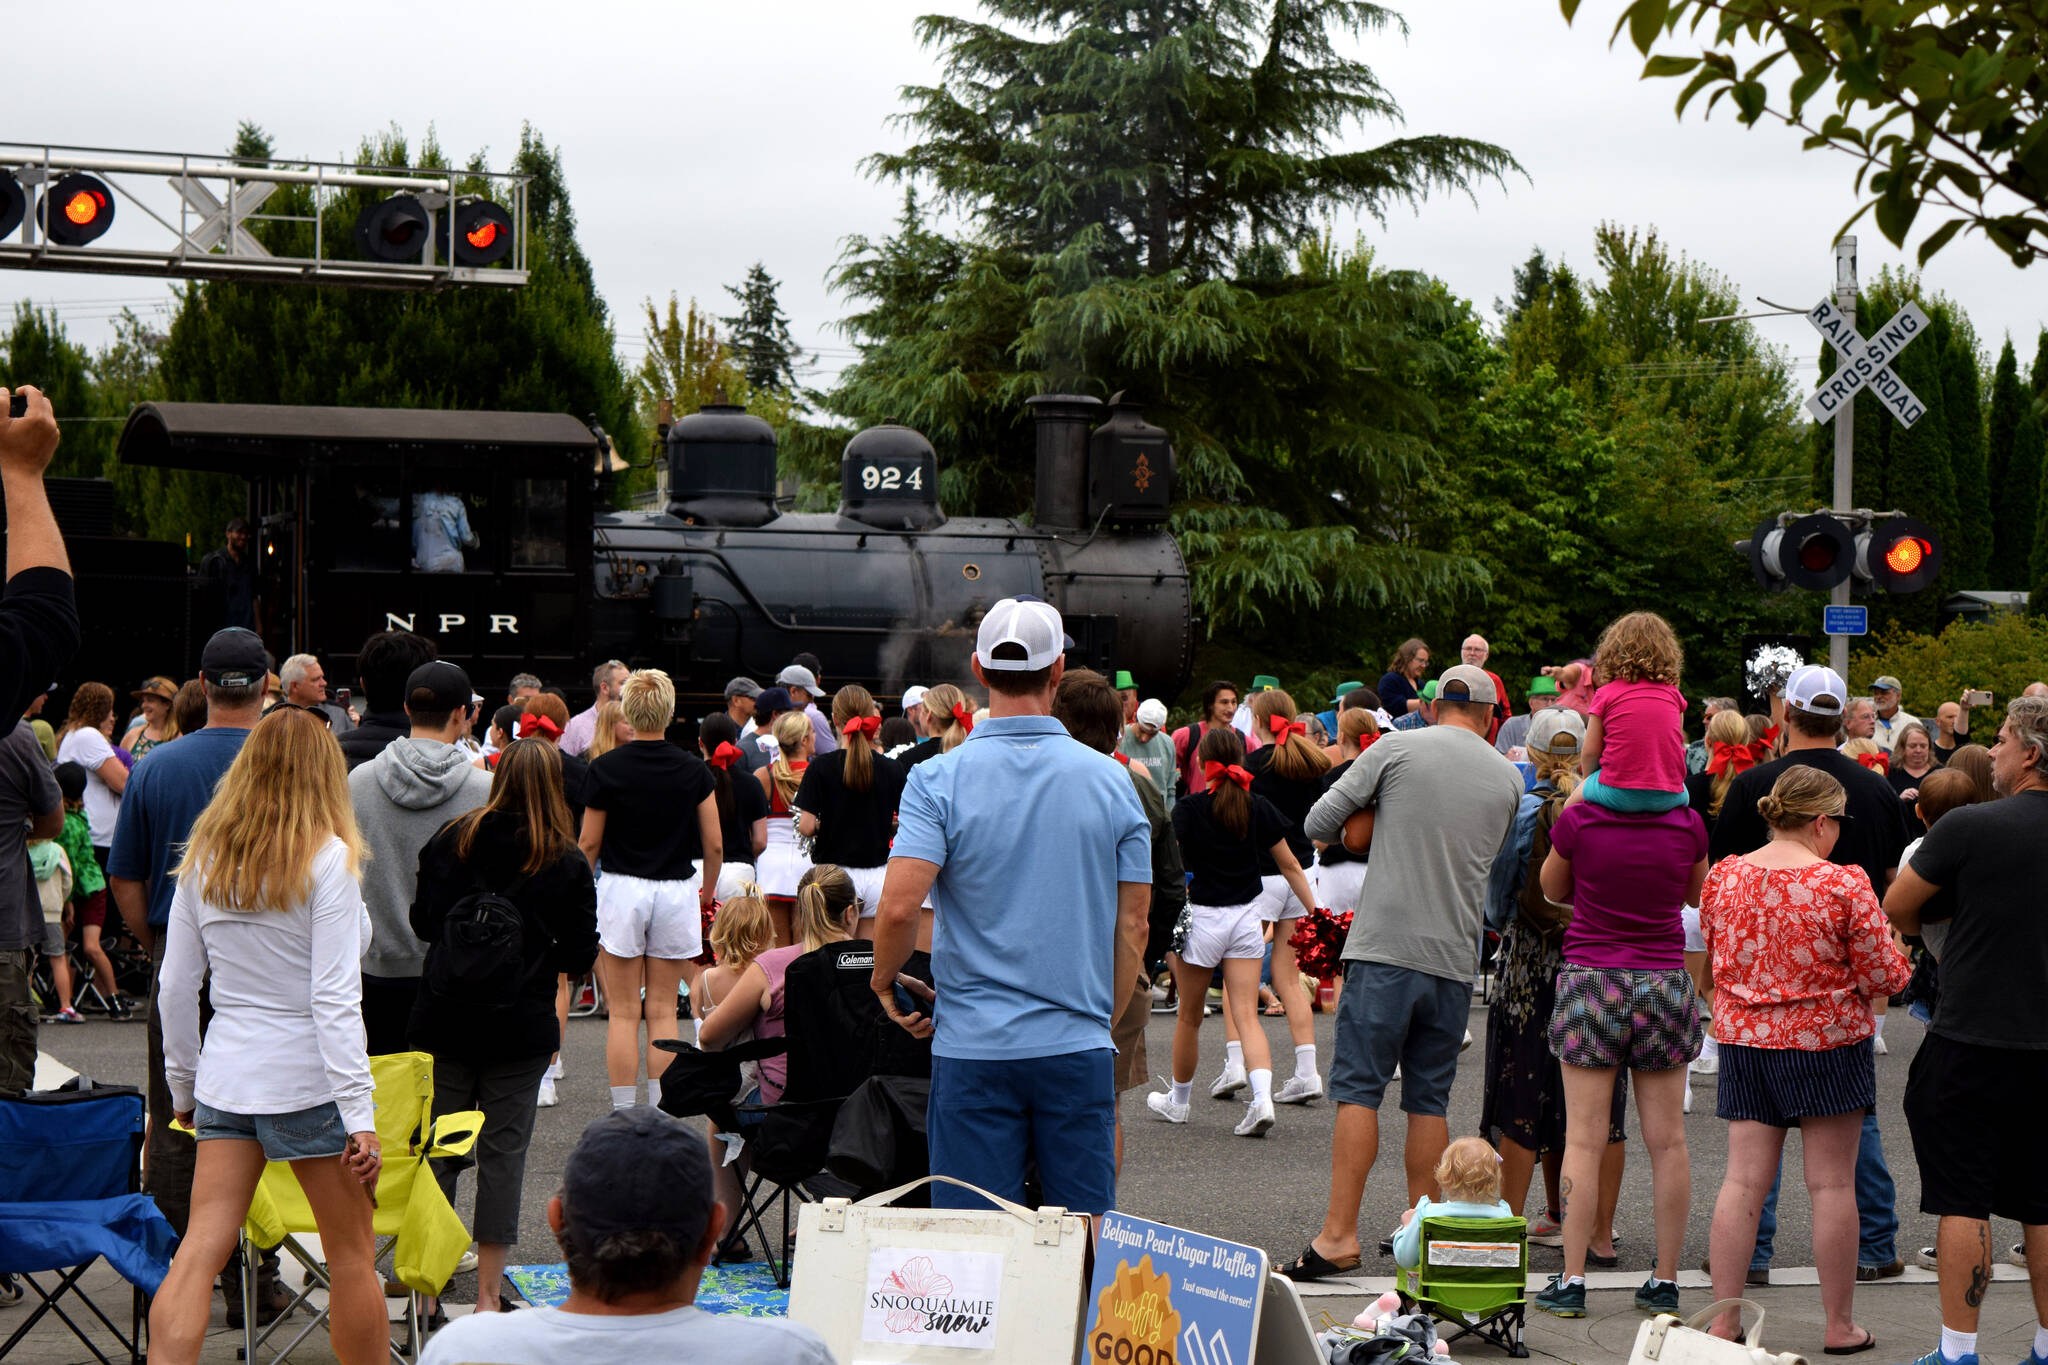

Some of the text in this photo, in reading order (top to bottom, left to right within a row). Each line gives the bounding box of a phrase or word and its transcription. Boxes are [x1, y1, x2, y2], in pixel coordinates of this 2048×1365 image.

[1813, 303, 1922, 424] RAIL ROAD
[1817, 314, 1918, 412] CROSSING
[861, 465, 923, 490] 924
[840, 954, 873, 965] Coleman
[1102, 1217, 1257, 1279] Belgian Pearl Sugar Waffles
[870, 1291, 995, 1316] SNOQUALMIE
[1181, 1277, 1253, 1309] Just around the corner!
[924, 1311, 990, 1334] snow
[1114, 1290, 1165, 1345] waffly
[1095, 1332, 1174, 1365] GOOD
